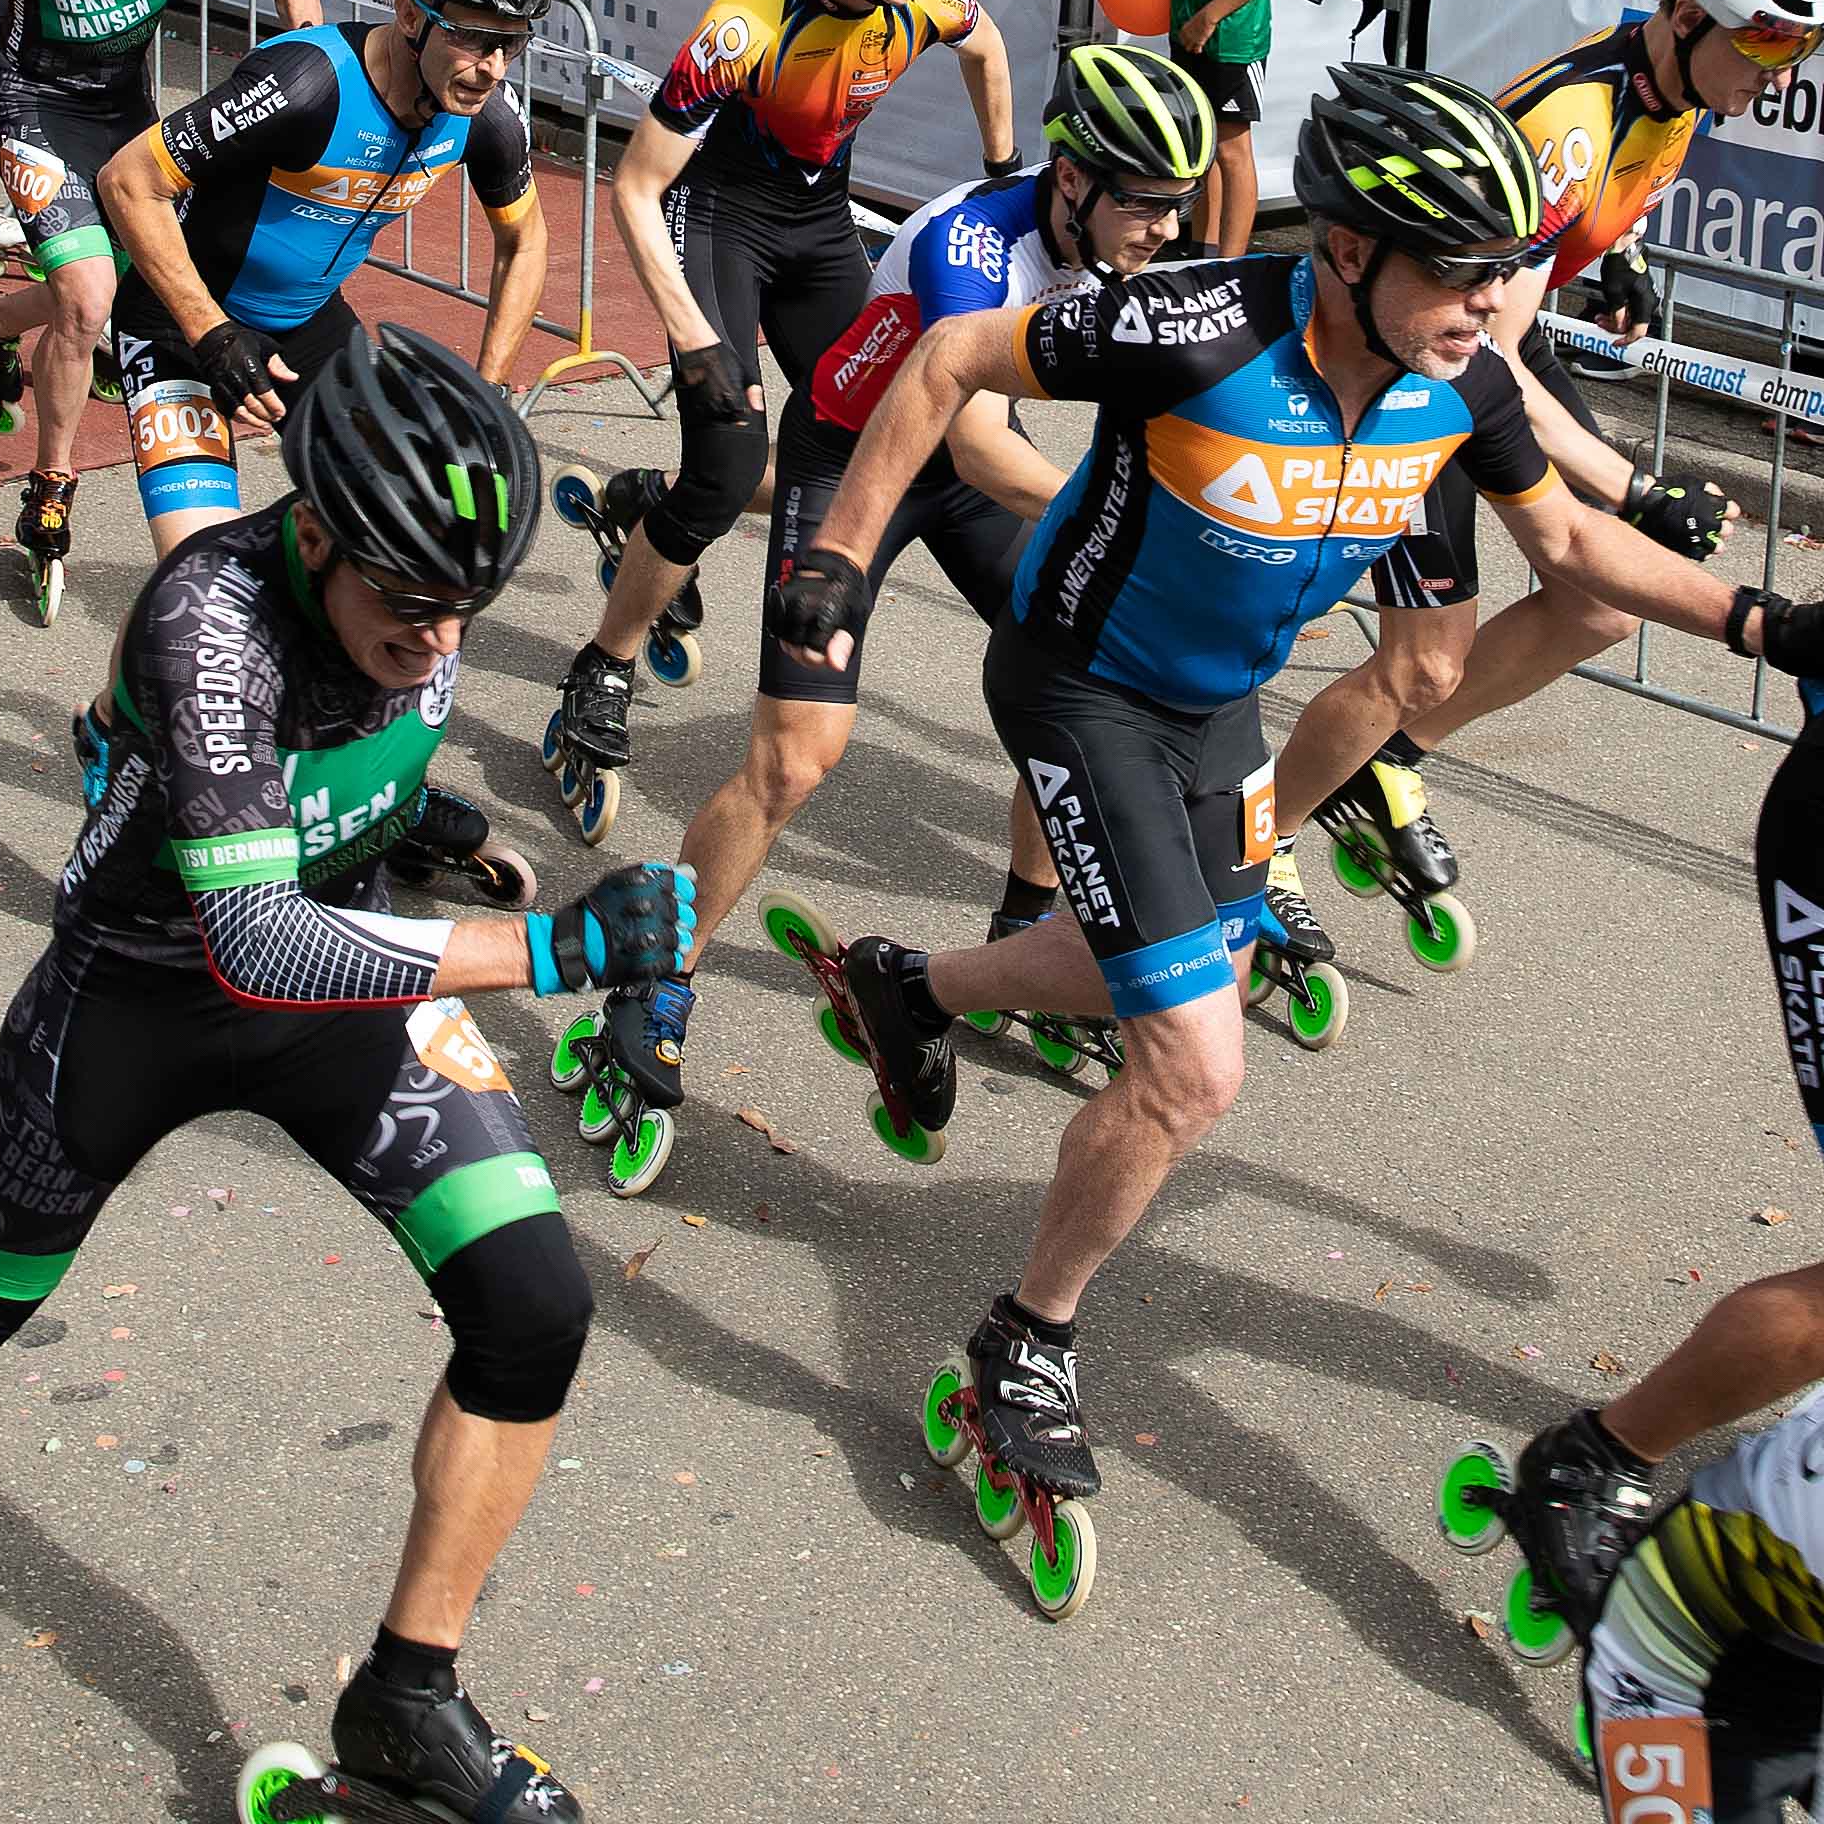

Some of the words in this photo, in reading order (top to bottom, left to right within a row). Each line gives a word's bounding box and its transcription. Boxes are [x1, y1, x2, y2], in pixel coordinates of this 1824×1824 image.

[689, 15, 751, 76] EO
[222, 72, 281, 115] PLANET
[234, 89, 290, 132] SKATE
[162, 121, 191, 174] MEISTER
[184, 110, 213, 161] HEMDEN
[358, 128, 397, 148] HEMDEN
[3, 159, 53, 201] 5100
[345, 156, 385, 170] MEISTER
[352, 173, 442, 194] PLANET
[1380, 174, 1445, 219] BASSO
[1148, 278, 1243, 317] PLANET
[1157, 303, 1248, 346] SKATE
[1642, 347, 1746, 396] ebmpapst
[137, 405, 222, 452] 5002
[1268, 417, 1330, 436] MEISTER
[199, 479, 233, 491] MEISTER
[1280, 450, 1442, 490] PLANET
[1292, 491, 1423, 527] SKATE
[303, 780, 398, 858] SEN
[181, 847, 208, 869] TSV
[1045, 815, 1095, 924] SKATE
[1059, 794, 1121, 929] PLANET
[1183, 948, 1225, 974] MEISTER
[1778, 951, 1820, 1090] SKATE
[442, 1018, 496, 1080] 50
[17, 1116, 65, 1164] TSV
[2, 1142, 78, 1192] BERN
[1614, 1743, 1687, 1824] 50
